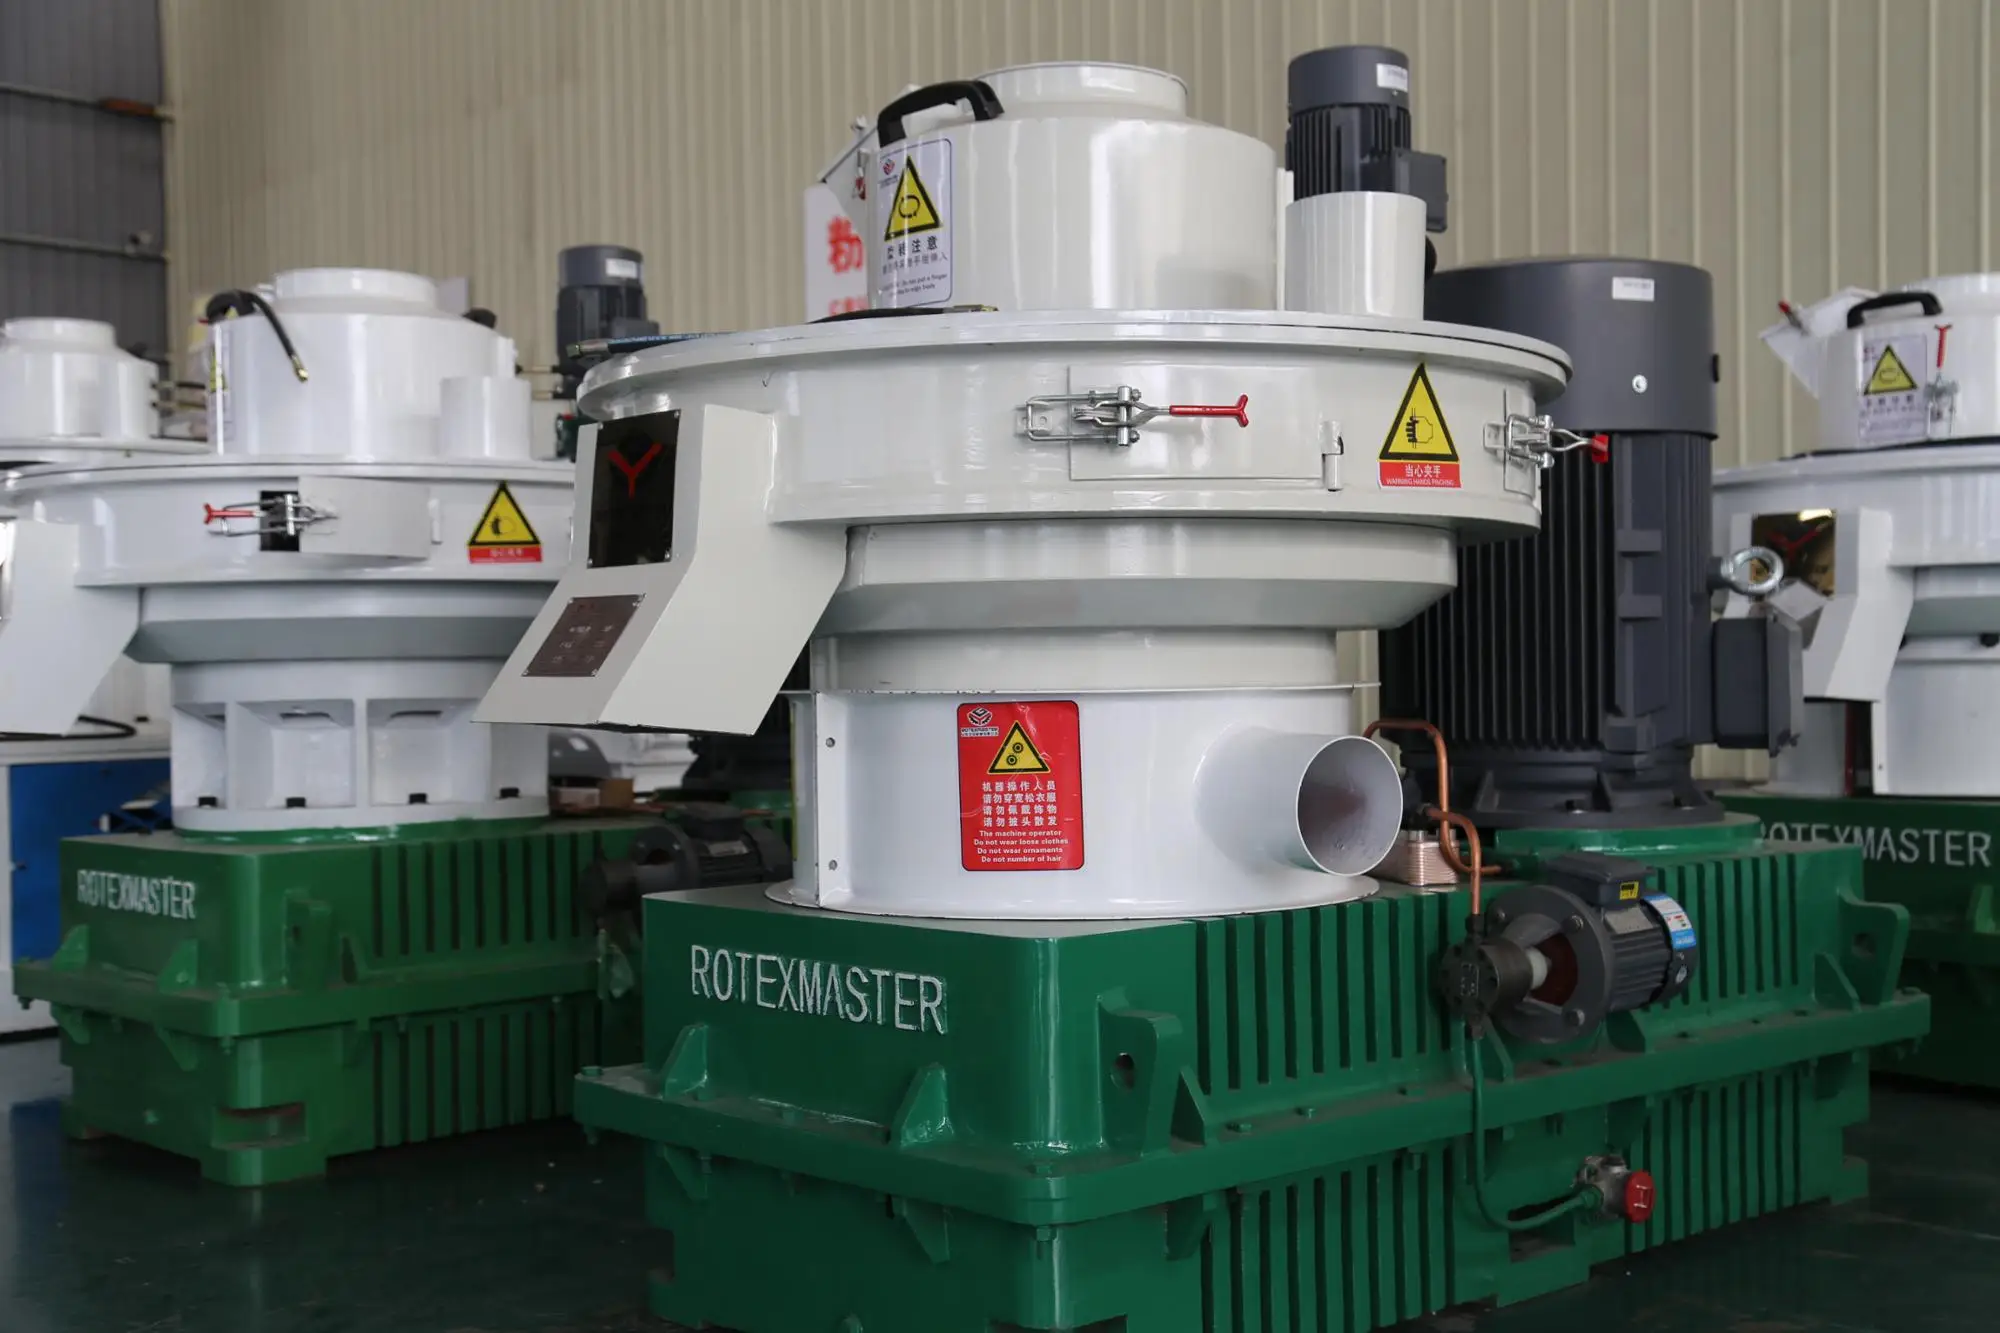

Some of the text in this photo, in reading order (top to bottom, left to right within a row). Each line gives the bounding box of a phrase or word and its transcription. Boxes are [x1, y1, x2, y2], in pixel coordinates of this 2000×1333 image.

[1404, 464, 1442, 478] 当心夹手
[1386, 477, 1412, 485] WARNING
[982, 780, 1056, 792] 机器操作人员
[982, 792, 1057, 804] 请勿穿宽松衣服
[983, 816, 1058, 828] 请勿披头散发
[1029, 830, 1062, 838] operator
[1760, 822, 1992, 867] OTEXMASTER
[77, 869, 197, 920] ROTEXMASTER
[691, 944, 949, 1035] ROTEXMASTER
